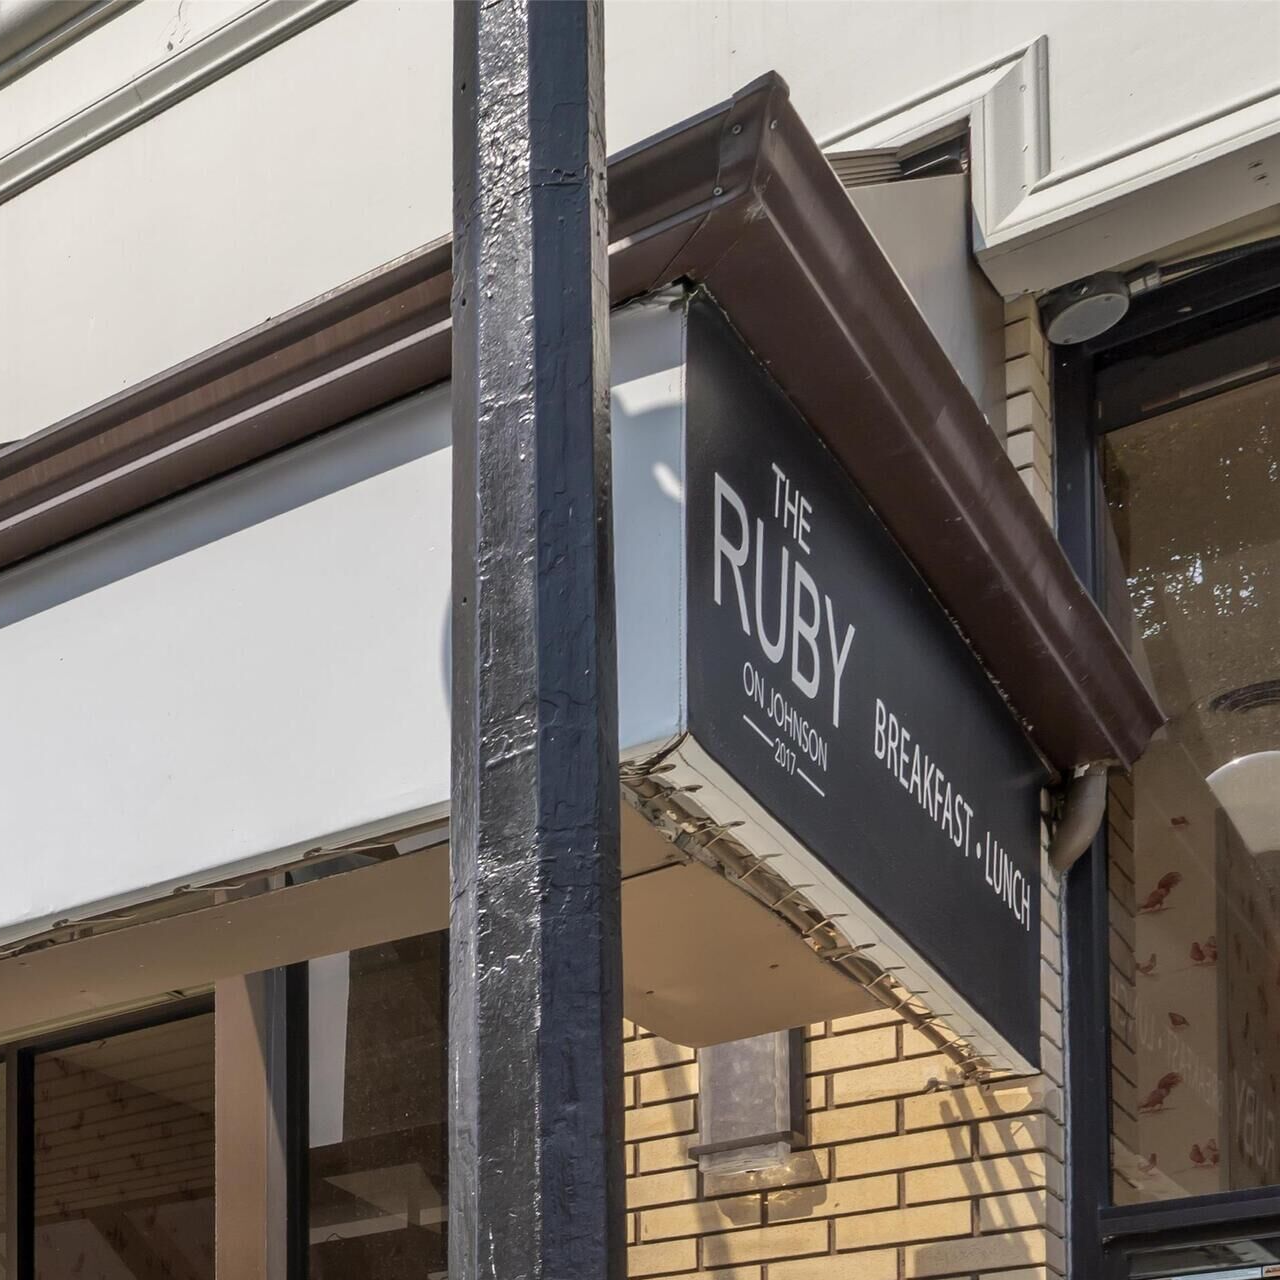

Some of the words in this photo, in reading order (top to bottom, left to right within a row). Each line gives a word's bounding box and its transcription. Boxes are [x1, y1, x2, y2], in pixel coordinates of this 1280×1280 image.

[771, 462, 813, 555] THE
[713, 471, 855, 728] RUBY
[743, 662, 764, 709] ON
[767, 687, 827, 772] JOHNSON
[774, 738, 796, 775] 2017
[874, 698, 974, 857] BREAKFAST
[985, 838, 1030, 931] LUNCH
